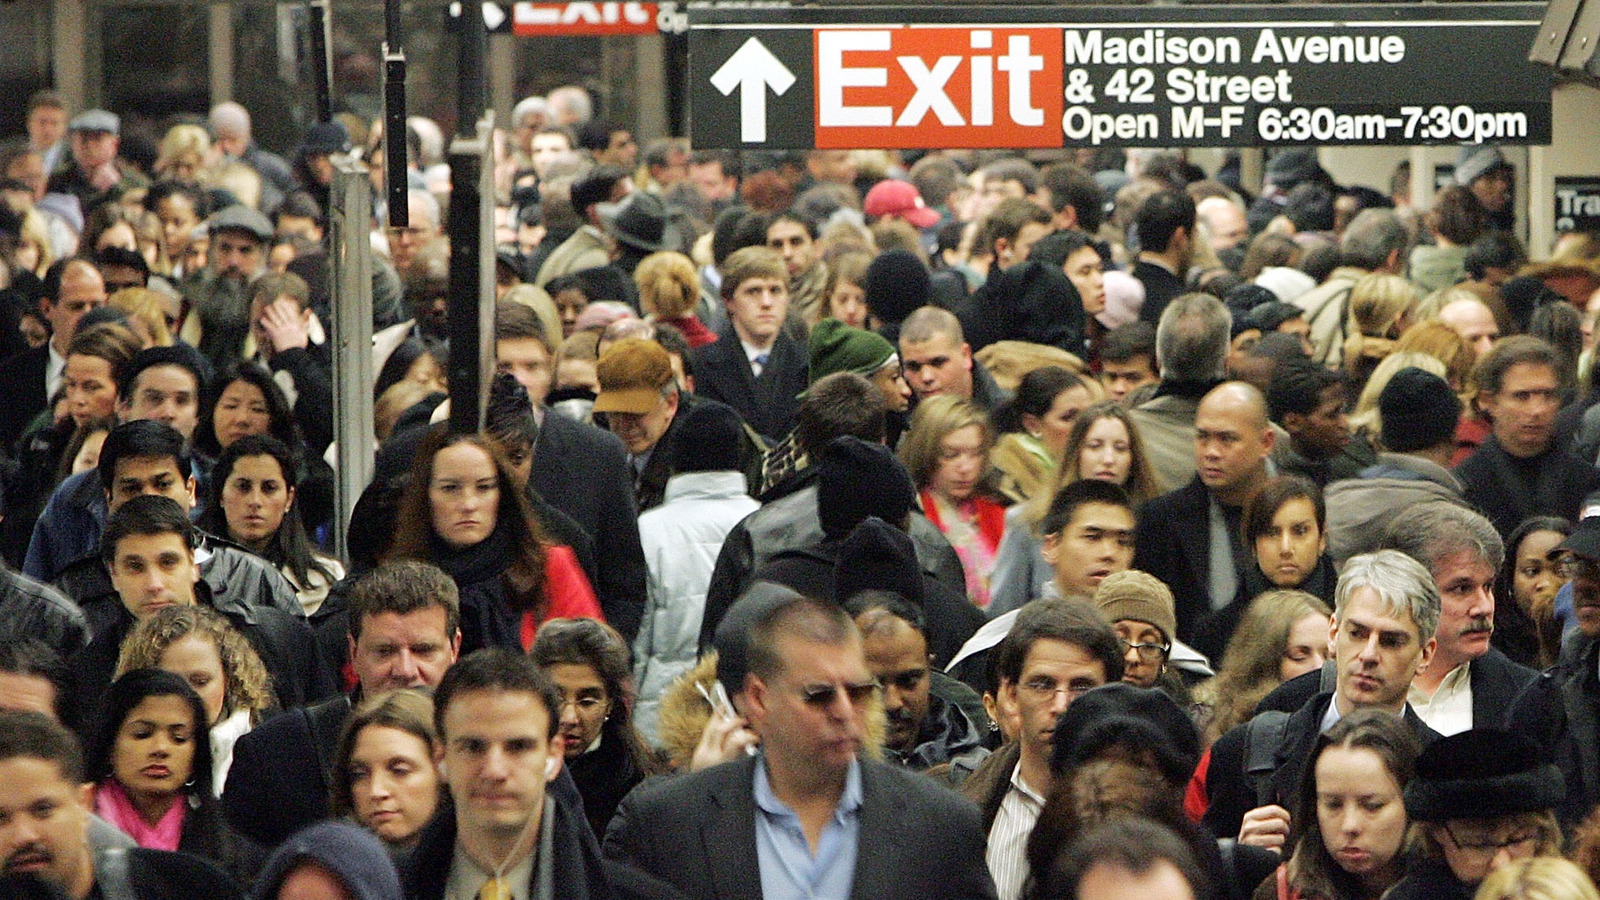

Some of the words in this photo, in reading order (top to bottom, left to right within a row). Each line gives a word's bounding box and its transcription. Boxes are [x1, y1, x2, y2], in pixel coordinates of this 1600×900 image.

[1064, 29, 1241, 64] Madison
[1252, 29, 1406, 64] Avenue
[818, 30, 1045, 127] Exit
[1065, 69, 1096, 103] &
[1105, 69, 1155, 103] 42
[1166, 68, 1293, 104] Street
[1062, 107, 1158, 145] Open
[1171, 107, 1245, 139] M-F
